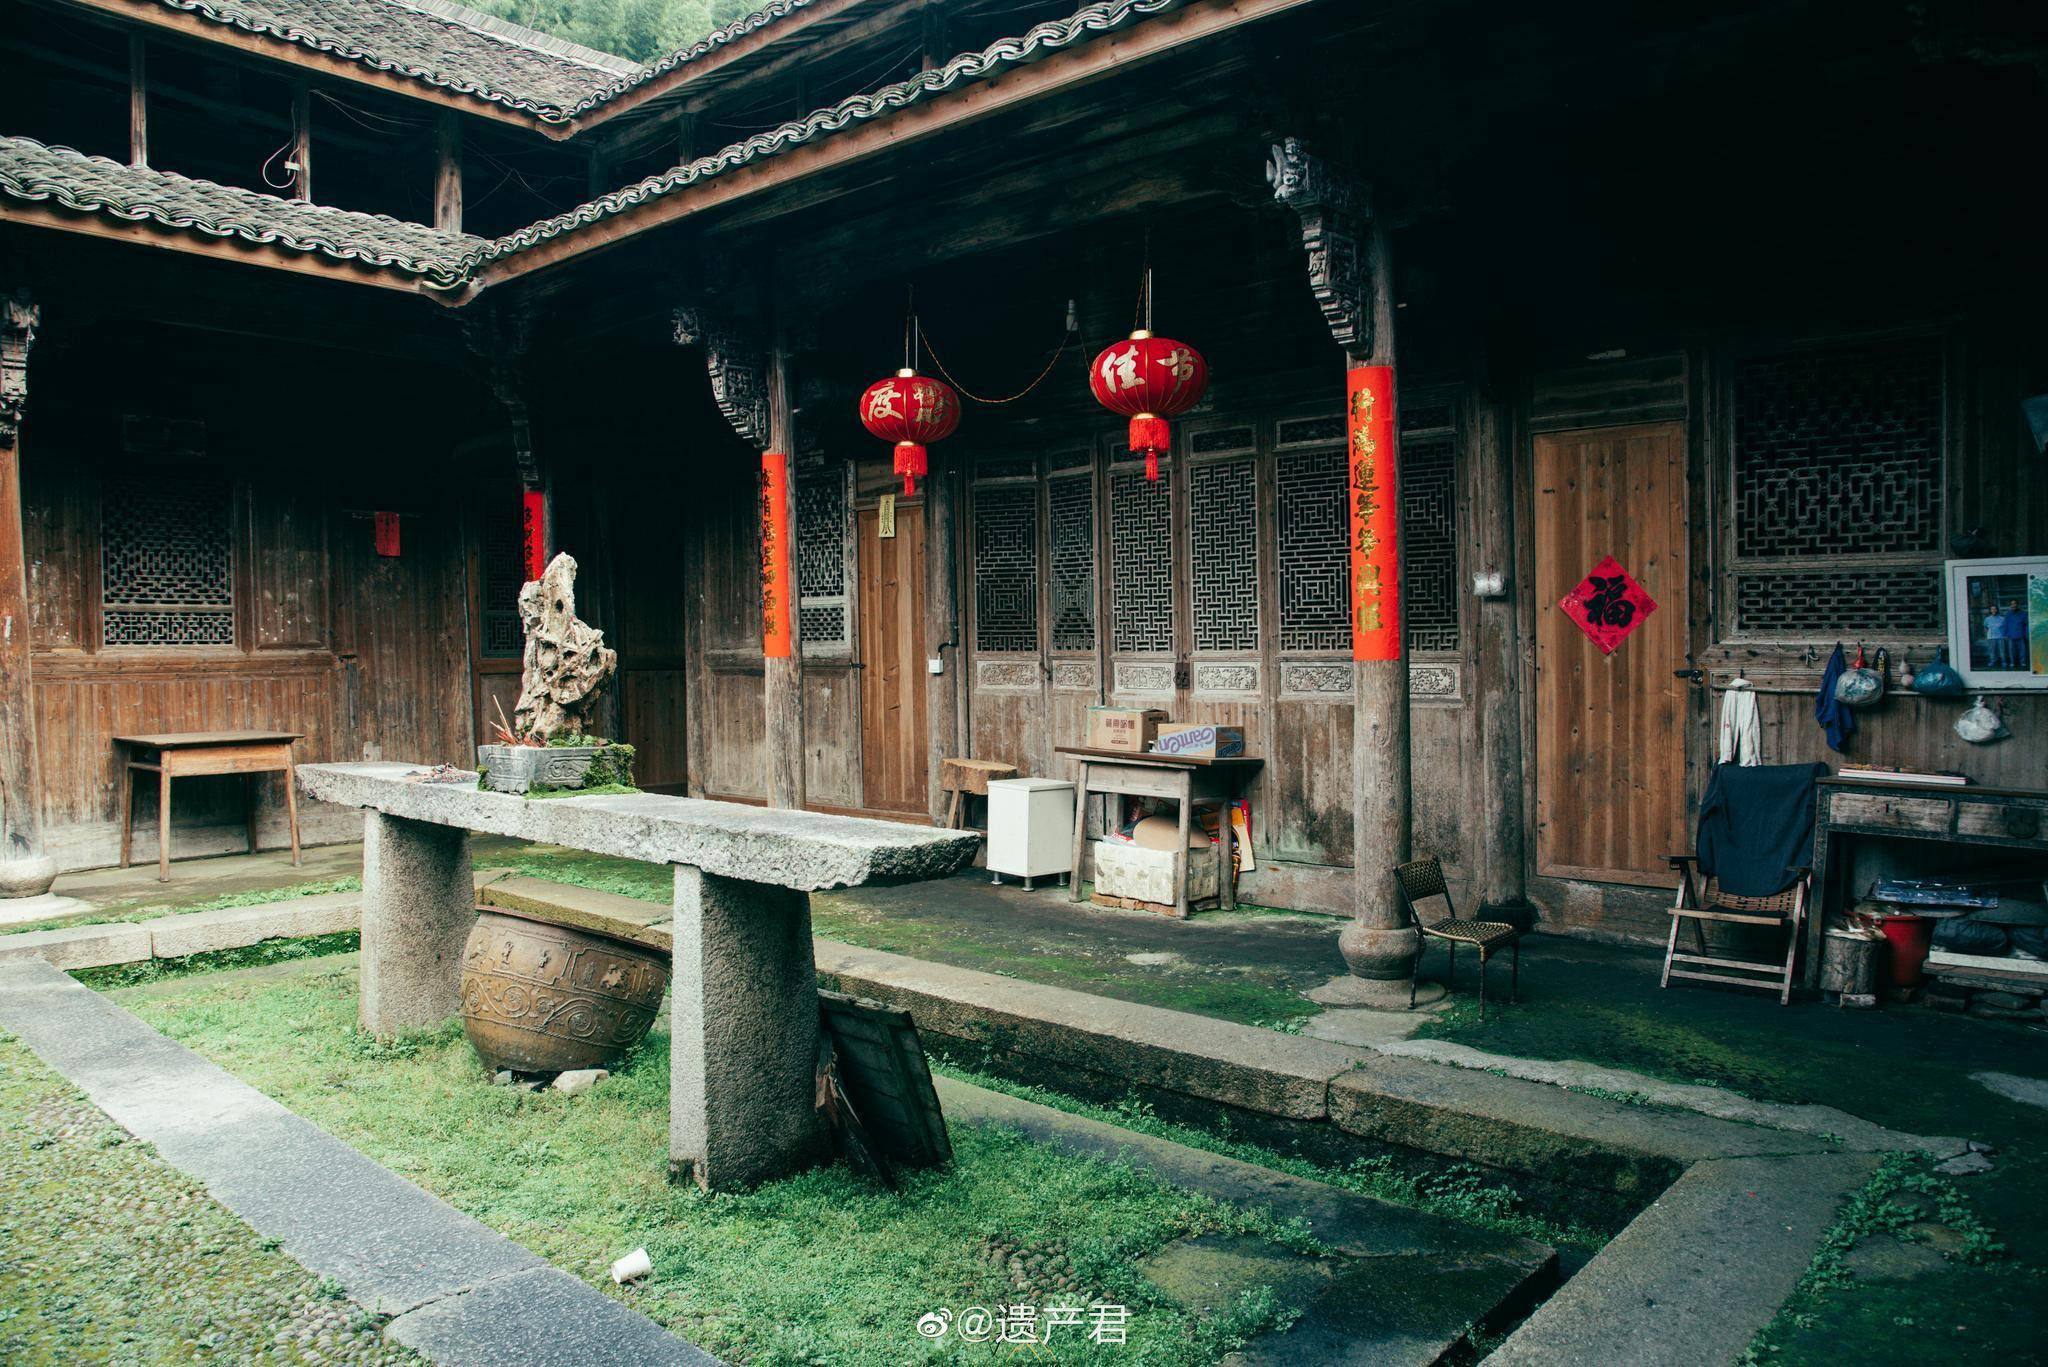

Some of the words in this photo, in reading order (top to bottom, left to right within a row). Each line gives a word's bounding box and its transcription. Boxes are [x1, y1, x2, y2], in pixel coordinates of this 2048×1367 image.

[1101, 345, 1199, 394] 佳节
[869, 381, 904, 422] 度
[1584, 575, 1637, 628] 福
